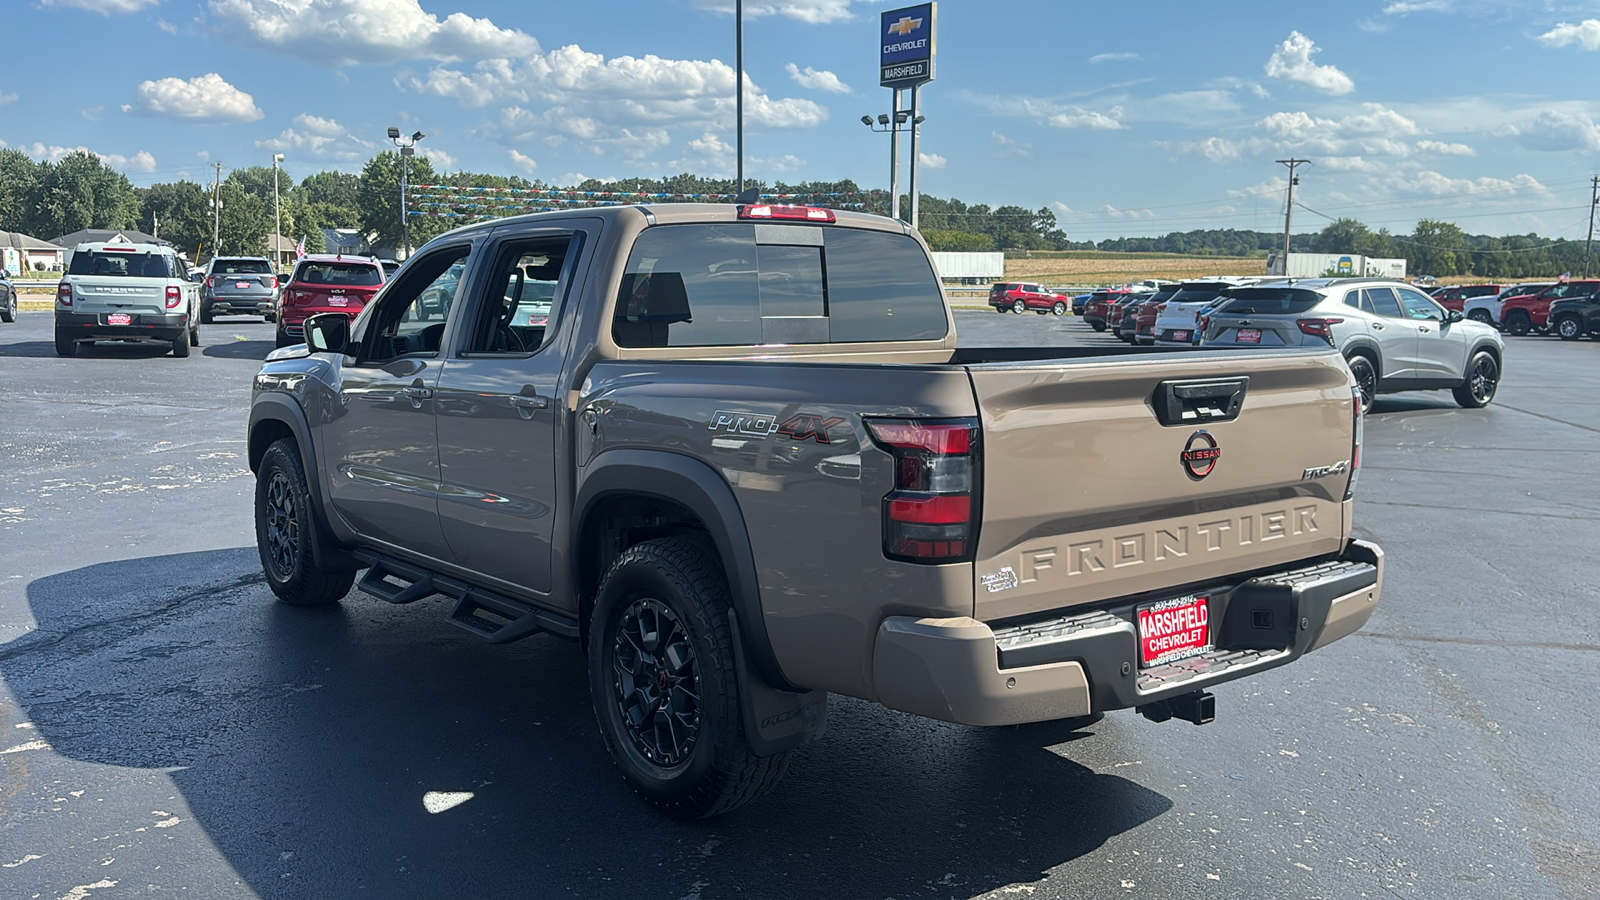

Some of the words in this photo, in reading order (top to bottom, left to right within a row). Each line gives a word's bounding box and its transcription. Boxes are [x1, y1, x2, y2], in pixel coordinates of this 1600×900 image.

[883, 39, 927, 54] CHEVROLET
[884, 64, 923, 79] MARSHFIELD
[1184, 449, 1220, 461] NISSAN
[1020, 504, 1318, 584] FRONTIER
[1139, 605, 1207, 639] MARSHFIELD
[1149, 629, 1202, 651] CHEVROLET
[1149, 652, 1181, 667] MARSHFIELD
[1180, 645, 1210, 659] CHEVROLET
